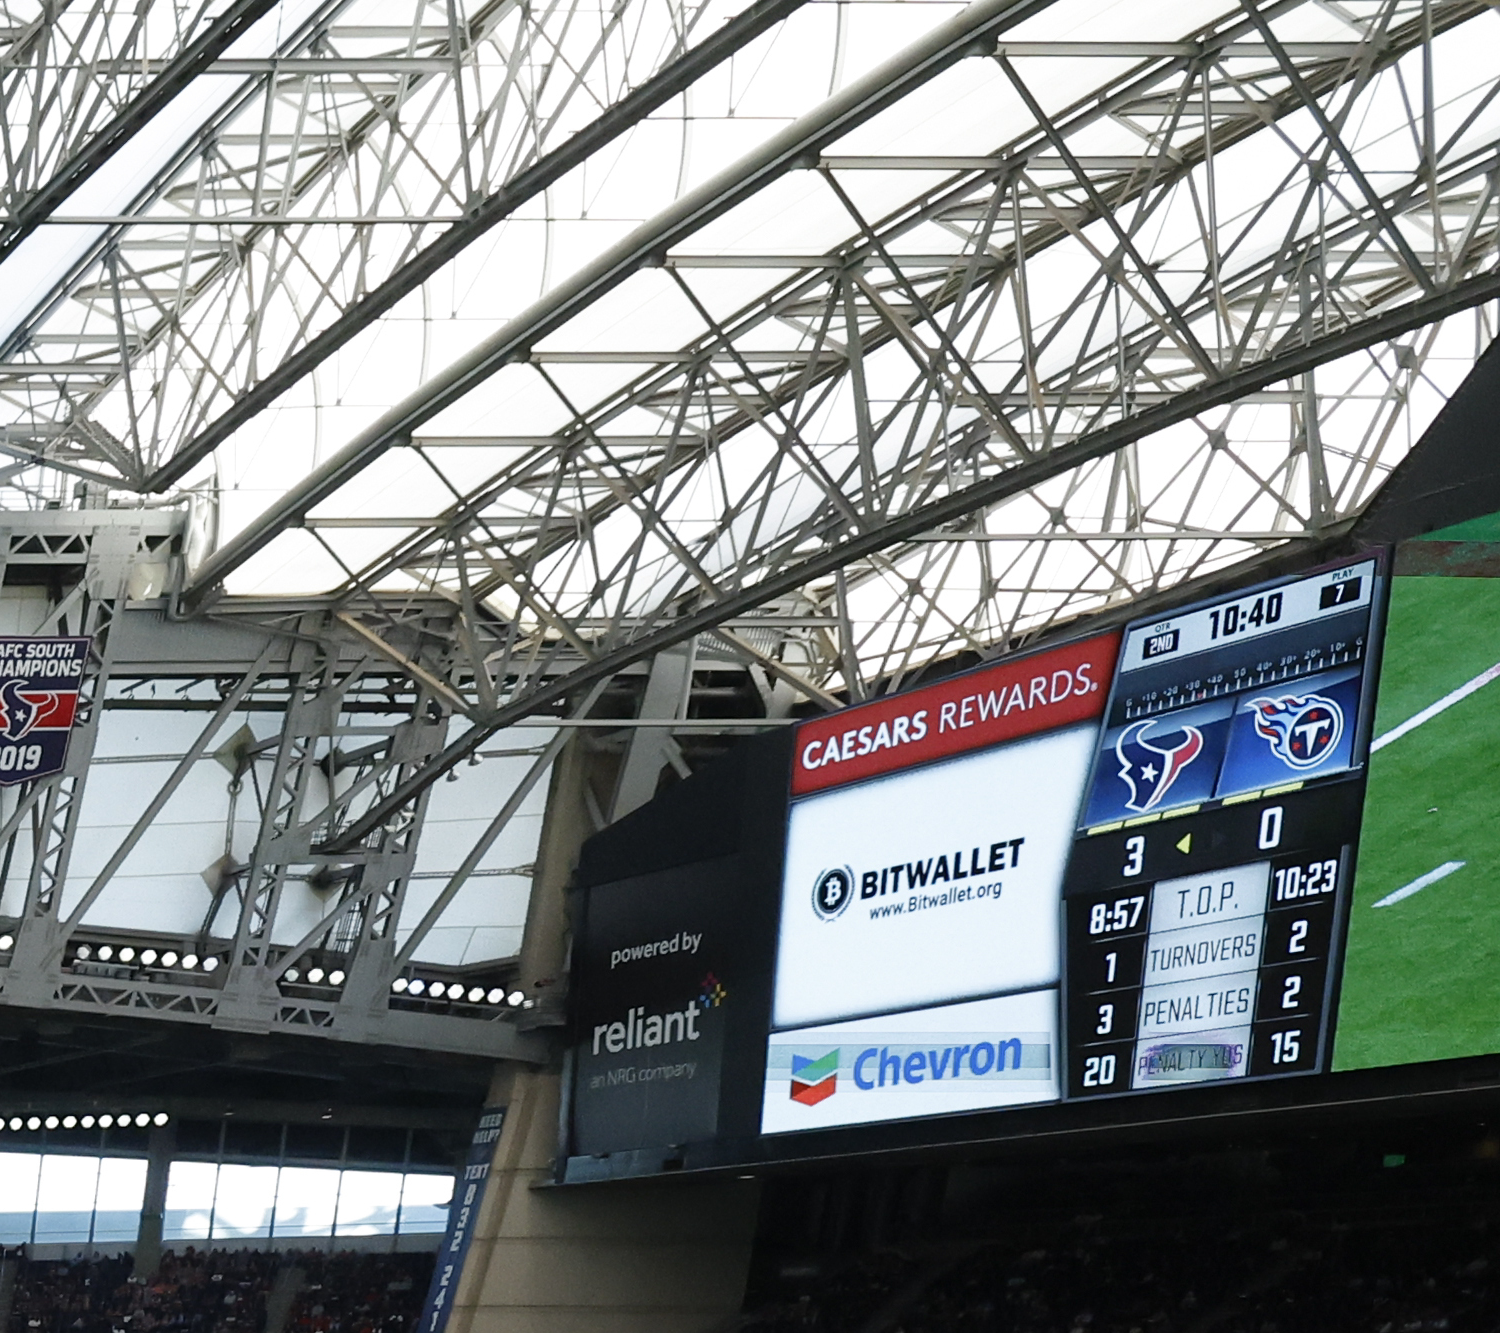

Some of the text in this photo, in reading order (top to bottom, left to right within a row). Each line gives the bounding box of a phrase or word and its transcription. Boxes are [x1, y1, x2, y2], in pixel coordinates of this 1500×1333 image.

[1332, 567, 1355, 582] PLAY
[1334, 584, 1346, 603] 7
[1209, 592, 1284, 641] 10:40
[25, 642, 76, 660] SOUTH
[1150, 634, 1175, 656] 2ND
[801, 709, 929, 772] CAESARS
[1258, 805, 1284, 850] 0
[860, 836, 1026, 901] BITWALLET
[1122, 835, 1146, 878] 3
[869, 879, 1003, 922] www.Bitwallet.org
[1088, 858, 1339, 936] 8:57 T.O.P. 10:23
[610, 931, 703, 969] powered by
[1105, 919, 1309, 984] 1 TURNOVERS 2
[591, 999, 701, 1057] reliant
[1096, 975, 1302, 1035] 3 PENALTIES 2
[590, 1060, 698, 1089] an NRG company
[852, 1034, 1023, 1092] Chevron
[1082, 1054, 1117, 1088] 20
[1270, 1029, 1302, 1065] 15
